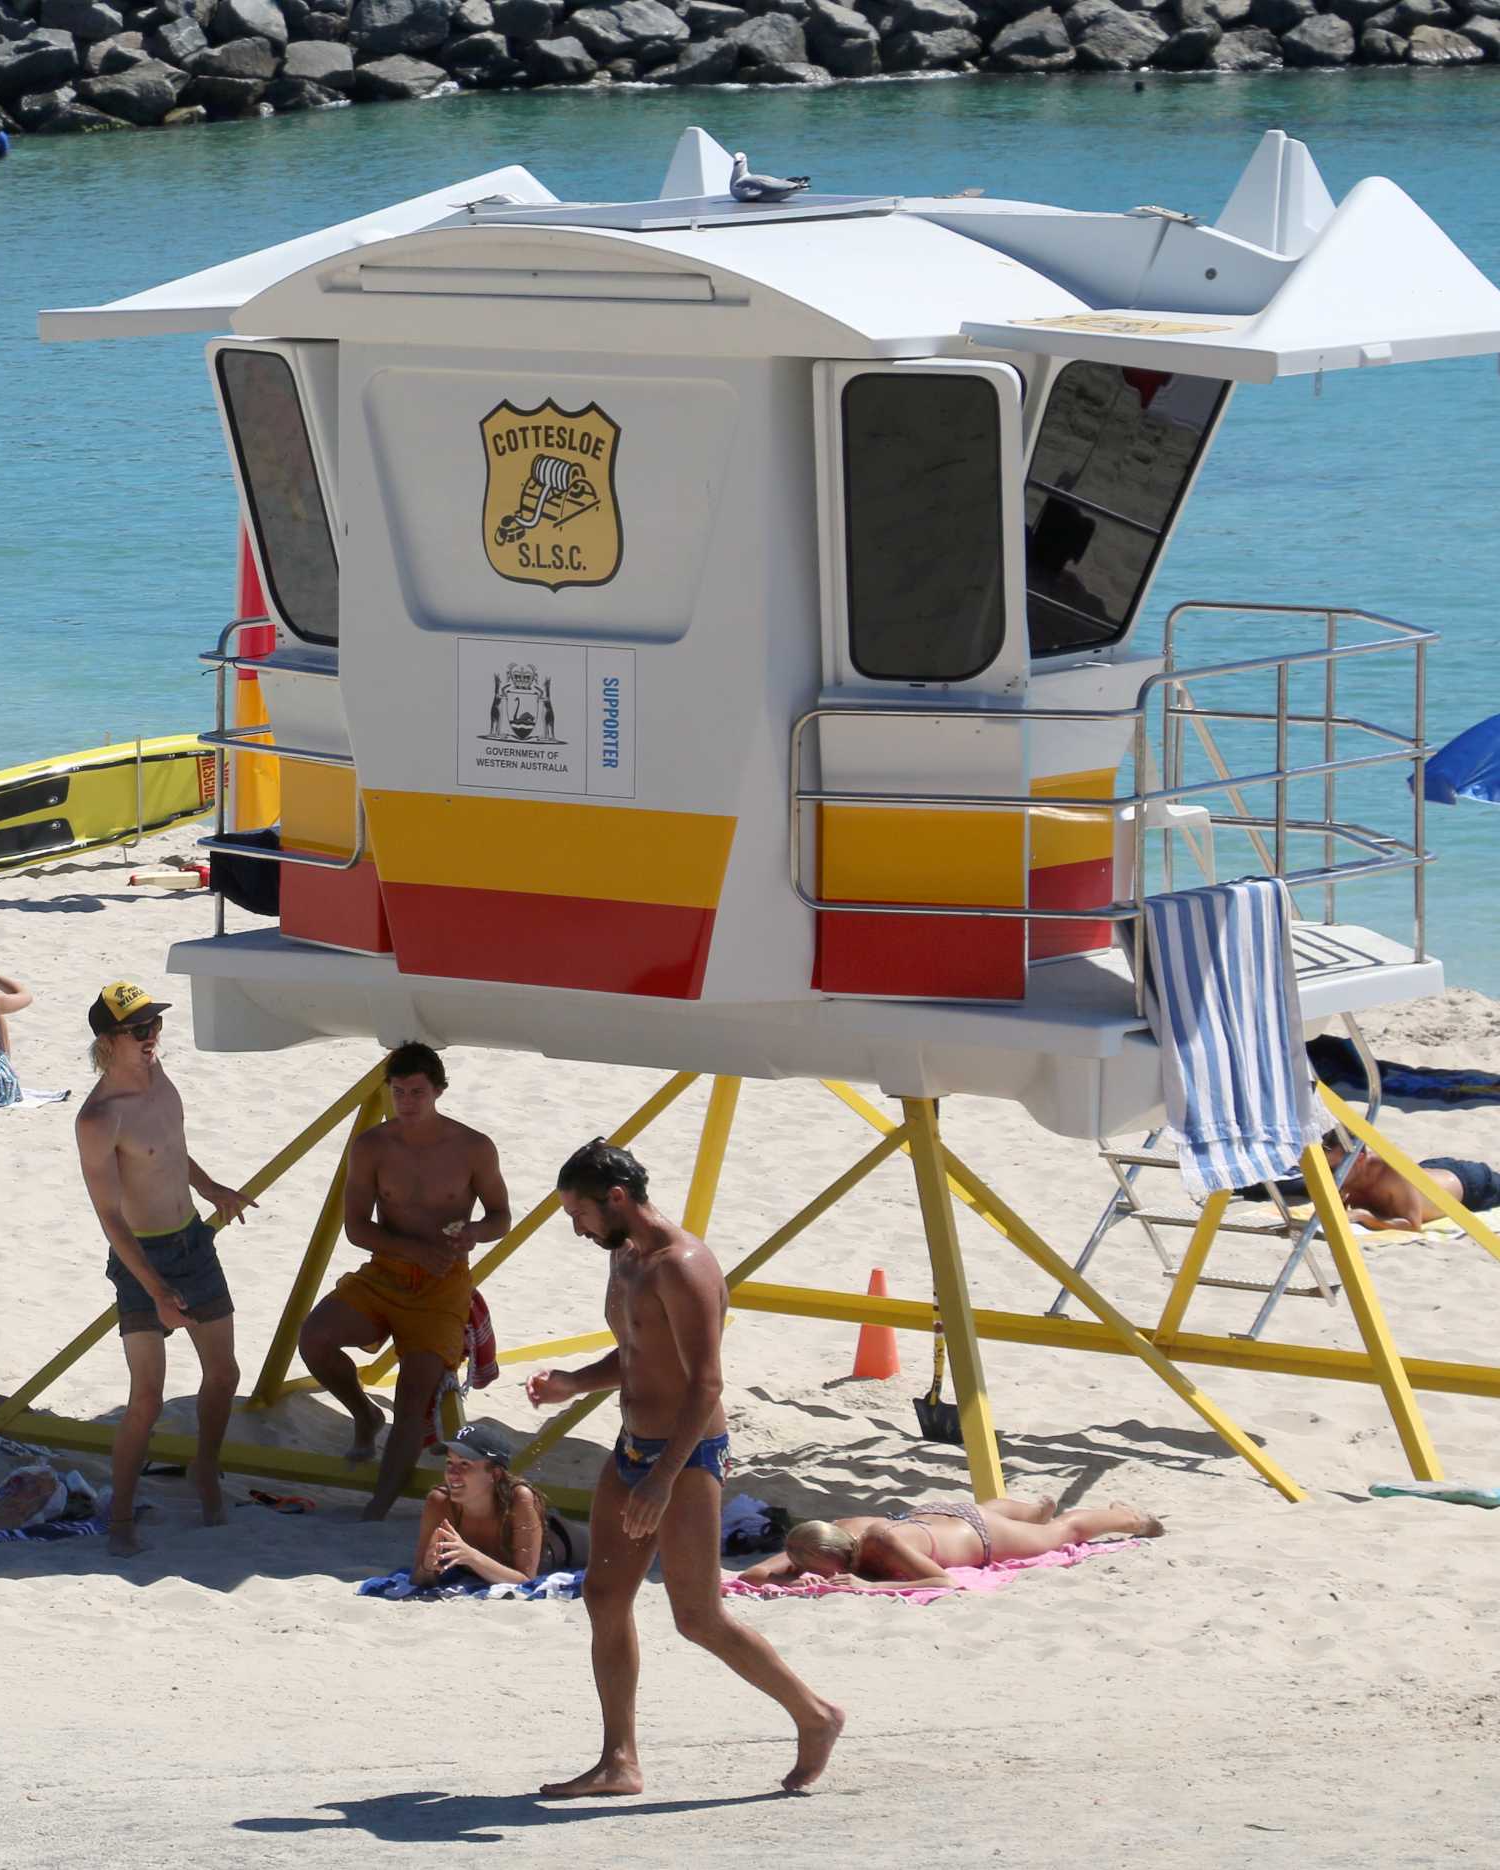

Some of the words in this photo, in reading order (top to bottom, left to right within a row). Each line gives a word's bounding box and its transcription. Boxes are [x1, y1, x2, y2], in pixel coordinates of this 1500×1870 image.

[492, 425, 606, 461] COTTESLOE
[518, 542, 587, 571] S.L.S.C.
[602, 677, 619, 769] SUPPORTER
[476, 758, 518, 769] WESTERN
[520, 761, 569, 773] AUSTRALIA
[486, 747, 545, 759] GOVERNMENT
[547, 751, 559, 760] OF
